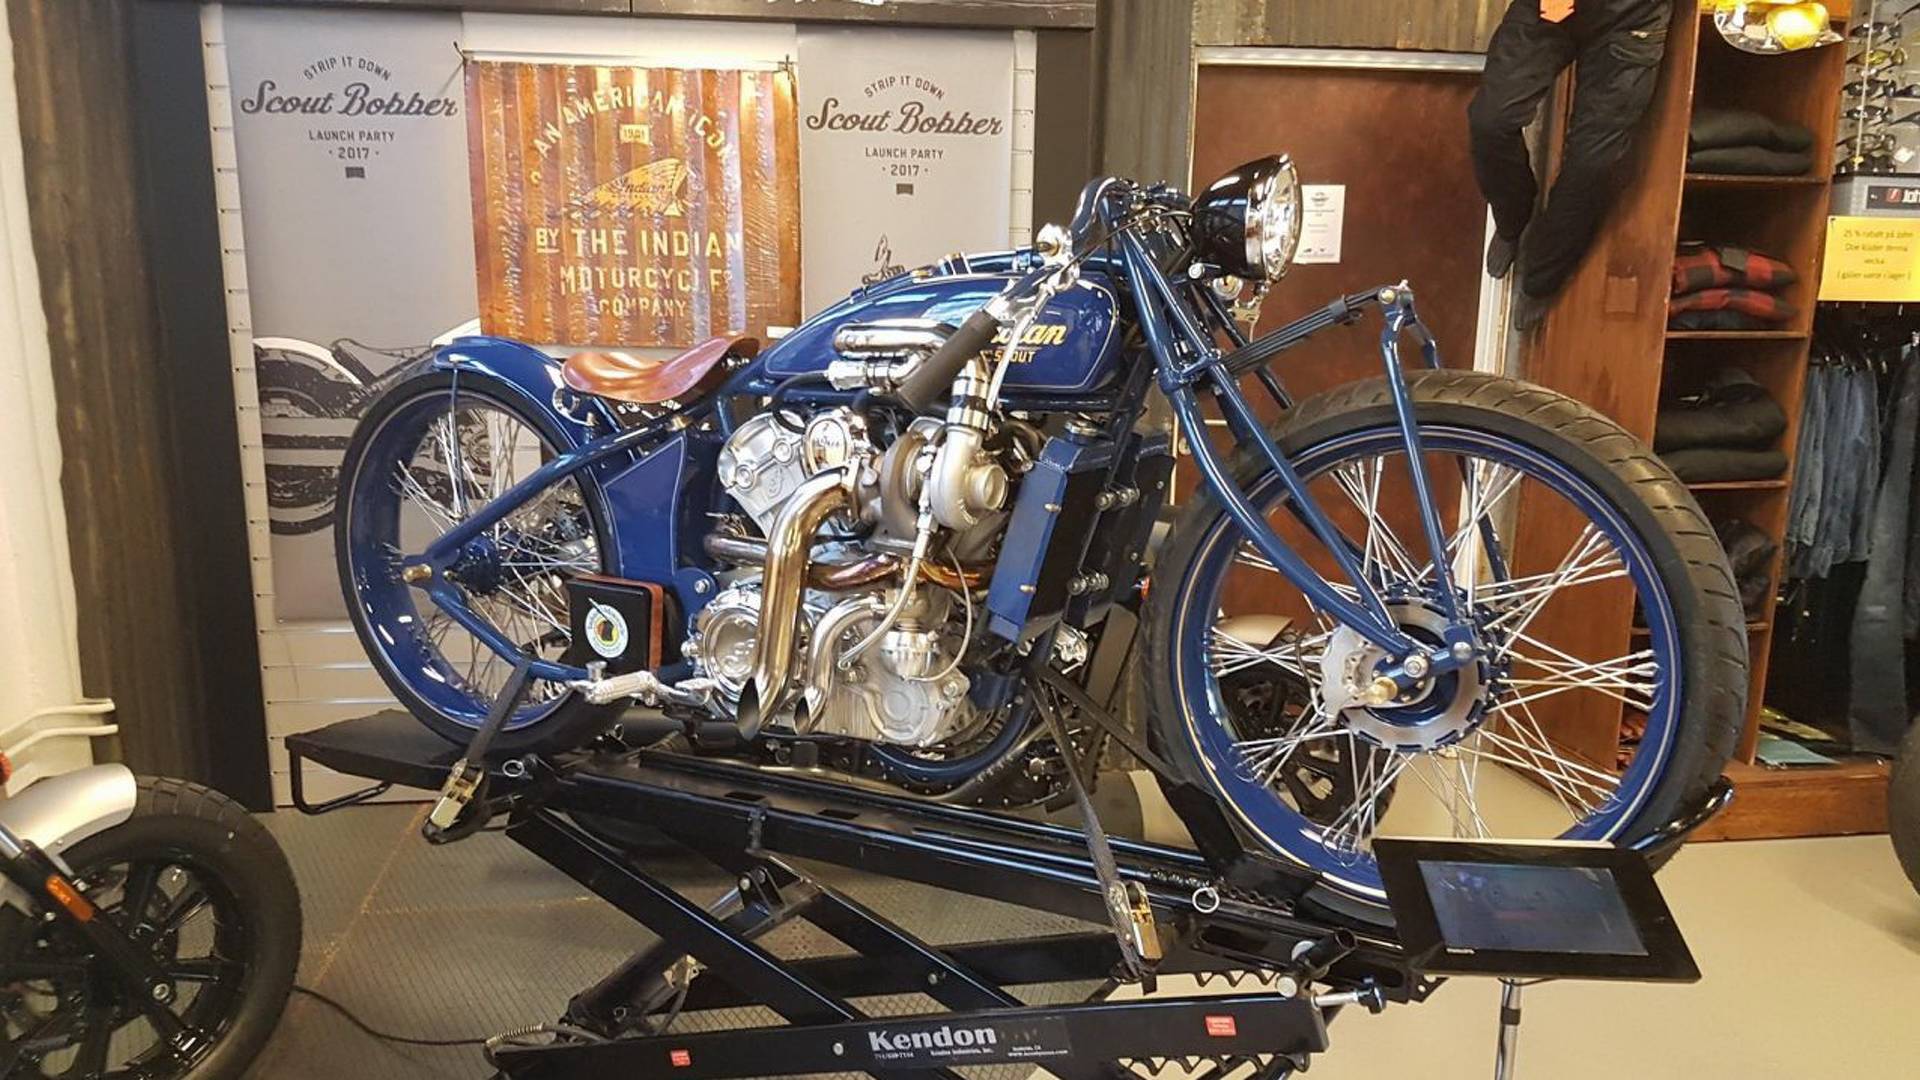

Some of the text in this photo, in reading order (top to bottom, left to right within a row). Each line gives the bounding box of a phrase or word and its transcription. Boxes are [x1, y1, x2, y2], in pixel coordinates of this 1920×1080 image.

[303, 56, 392, 82] STRIP IT DOWN
[240, 80, 458, 117] Scout Bobber
[864, 75, 945, 101] STRIP IT DOWN
[533, 121, 562, 158] AN
[562, 85, 686, 125] AMERIAN
[806, 97, 1004, 136] Scout Bobber
[308, 129, 396, 142] LAUNCH PARTY
[338, 147, 371, 160] 2017
[864, 147, 944, 160] LAUNCH PARTY
[890, 164, 920, 177] 2017
[535, 228, 741, 258] BY THE INDIAN
[598, 296, 688, 318] COMPANY
[994, 350, 1036, 363] SOUT
[867, 1026, 997, 1052] Kendon
